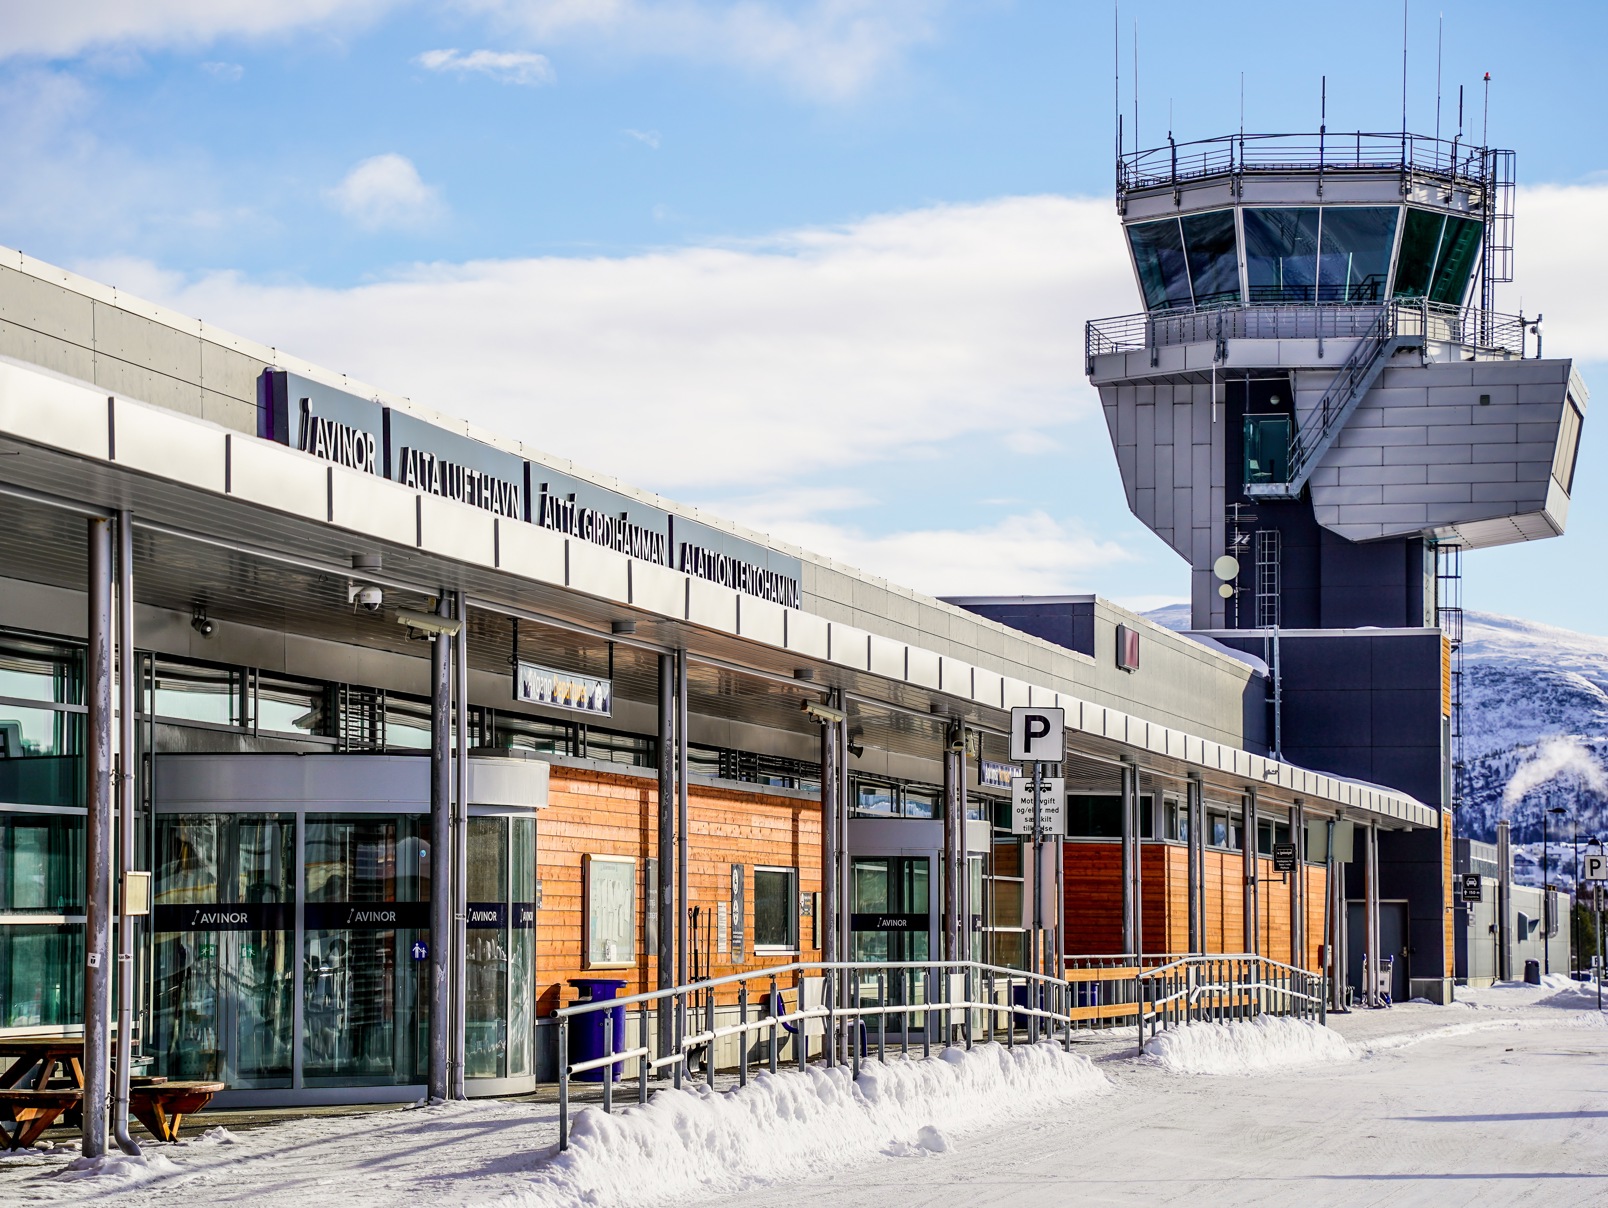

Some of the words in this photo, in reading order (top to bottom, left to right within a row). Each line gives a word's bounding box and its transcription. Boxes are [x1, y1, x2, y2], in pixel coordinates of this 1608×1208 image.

[314, 416, 376, 475] AVINOR
[402, 446, 441, 496] ALTA
[444, 461, 520, 520] LUFTHAVN
[541, 482, 581, 539] ÁLTTÁ
[583, 508, 667, 567] GIRDIHÁMMAN
[682, 542, 734, 590] ALATTION
[735, 560, 800, 611] LENTOHAMINA
[1024, 714, 1051, 754] P
[1036, 798, 1056, 806] vgift
[1016, 807, 1042, 815] og/elr
[1589, 858, 1602, 877] P
[200, 912, 248, 924] AVINOR
[354, 911, 396, 922] AVINOR
[471, 911, 498, 922] AVINOR
[881, 919, 908, 927] AVINOR
